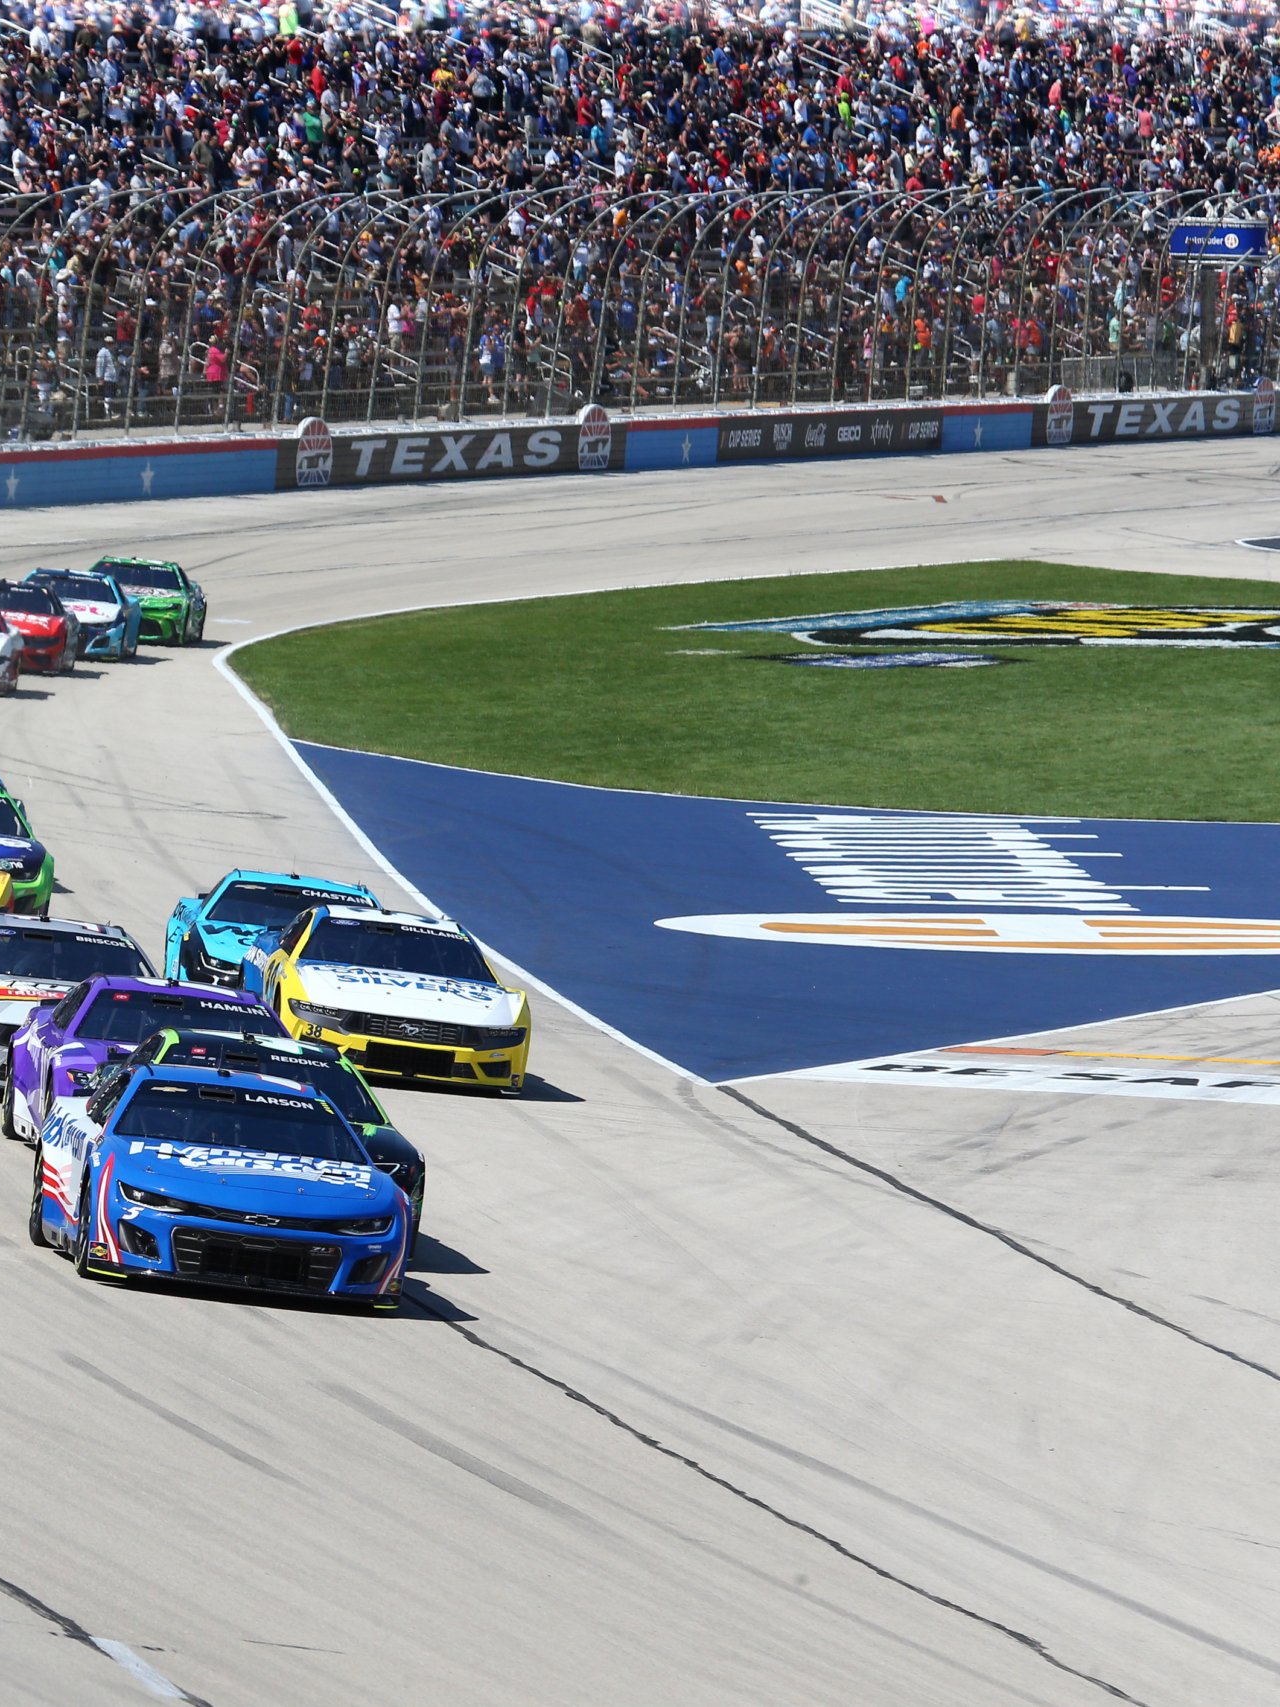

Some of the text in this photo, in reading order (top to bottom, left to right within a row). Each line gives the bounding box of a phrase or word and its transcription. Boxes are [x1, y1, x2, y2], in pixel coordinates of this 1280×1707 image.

[1087, 399, 1241, 436] TEXAS
[773, 423, 793, 442] BUSCH
[837, 425, 861, 442] GEICO
[870, 418, 894, 446] xfinity
[351, 430, 562, 477] TEXAS
[302, 888, 371, 906] CHASTAIN
[76, 935, 127, 948] BRISCOE
[401, 925, 469, 942] GILLILAND
[200, 1000, 263, 1016] HAMLIN
[305, 1023, 322, 1038] 38
[271, 1054, 330, 1069] REDDICK
[245, 1093, 314, 1111] LARSON
[122, 1206, 145, 1220] 5
